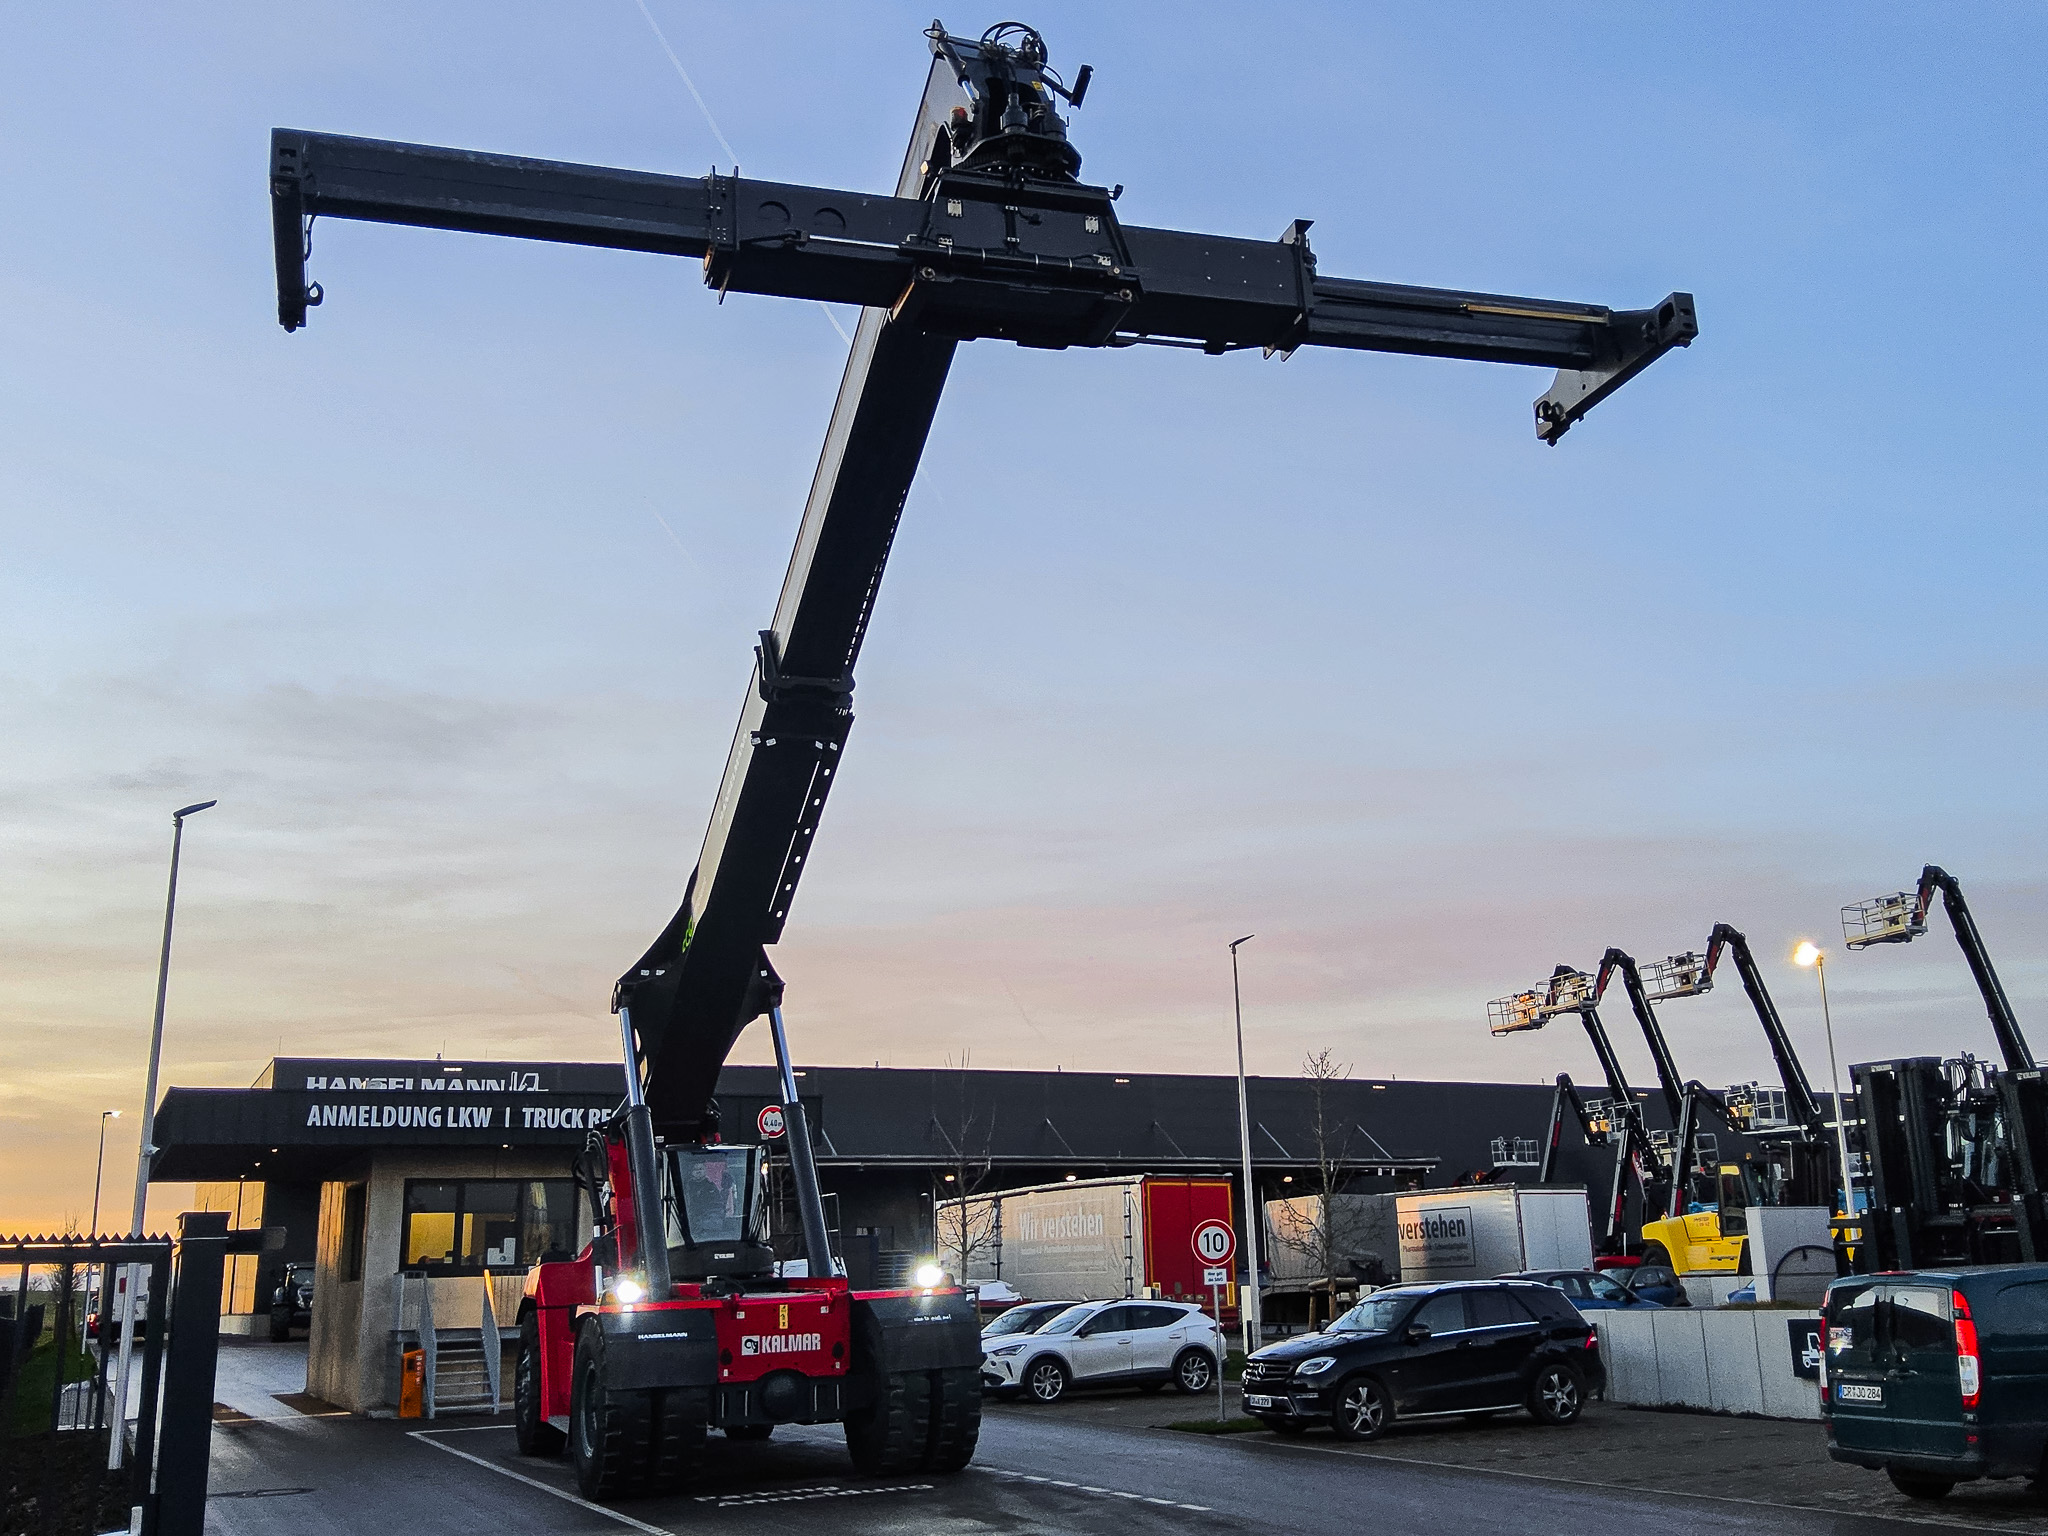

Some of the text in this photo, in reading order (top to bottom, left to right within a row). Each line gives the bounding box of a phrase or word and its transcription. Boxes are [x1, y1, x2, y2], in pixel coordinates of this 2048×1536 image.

[306, 1105, 441, 1127] ANMELDUNG
[447, 1106, 493, 1128] LKW
[522, 1107, 584, 1129] TRUCK
[1020, 1206, 1103, 1240] Wir verstehen
[1398, 1213, 1466, 1240] verstehen
[1203, 1232, 1224, 1253] 10
[761, 1333, 821, 1354] KALMAR
[1867, 1388, 1881, 1399] 284
